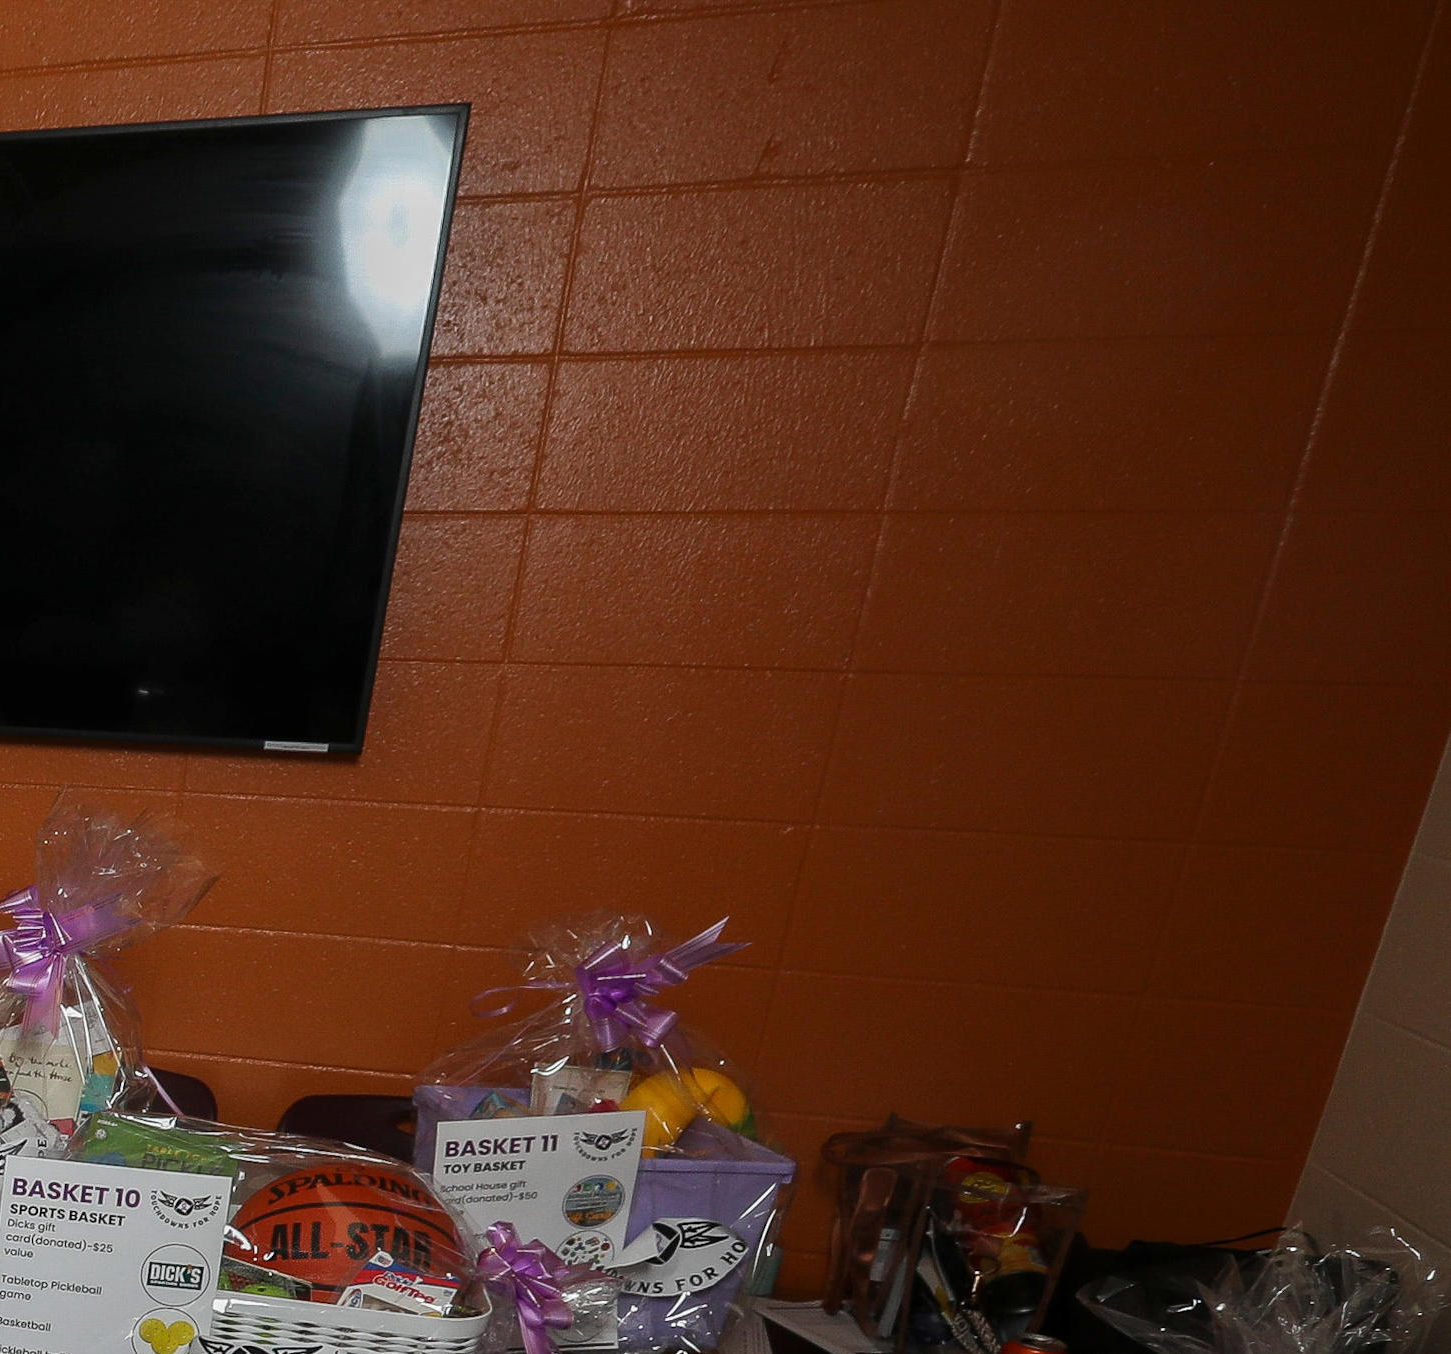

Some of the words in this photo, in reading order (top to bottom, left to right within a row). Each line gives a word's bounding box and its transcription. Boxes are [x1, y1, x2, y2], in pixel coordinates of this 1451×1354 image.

[444, 1136, 537, 1158] BASKET
[541, 1135, 559, 1152] 11
[443, 1163, 471, 1174] TOY
[473, 1160, 526, 1172] BASKET
[12, 1178, 109, 1205] BASKET
[116, 1188, 141, 1208] 10
[509, 1180, 527, 1191] gift
[7, 1218, 35, 1231] Dicks
[38, 1221, 55, 1233] gift
[9, 1203, 65, 1220] SPORTS
[69, 1210, 125, 1227] BASKET
[4, 1247, 34, 1259] value
[5, 1232, 113, 1254] card(donated)-$25
[270, 1221, 433, 1273] ALL-STAR
[150, 1263, 202, 1284] DICK'S
[0, 1289, 32, 1301] game
[1, 1274, 47, 1290] Tabletop
[50, 1281, 102, 1296] Pickleball
